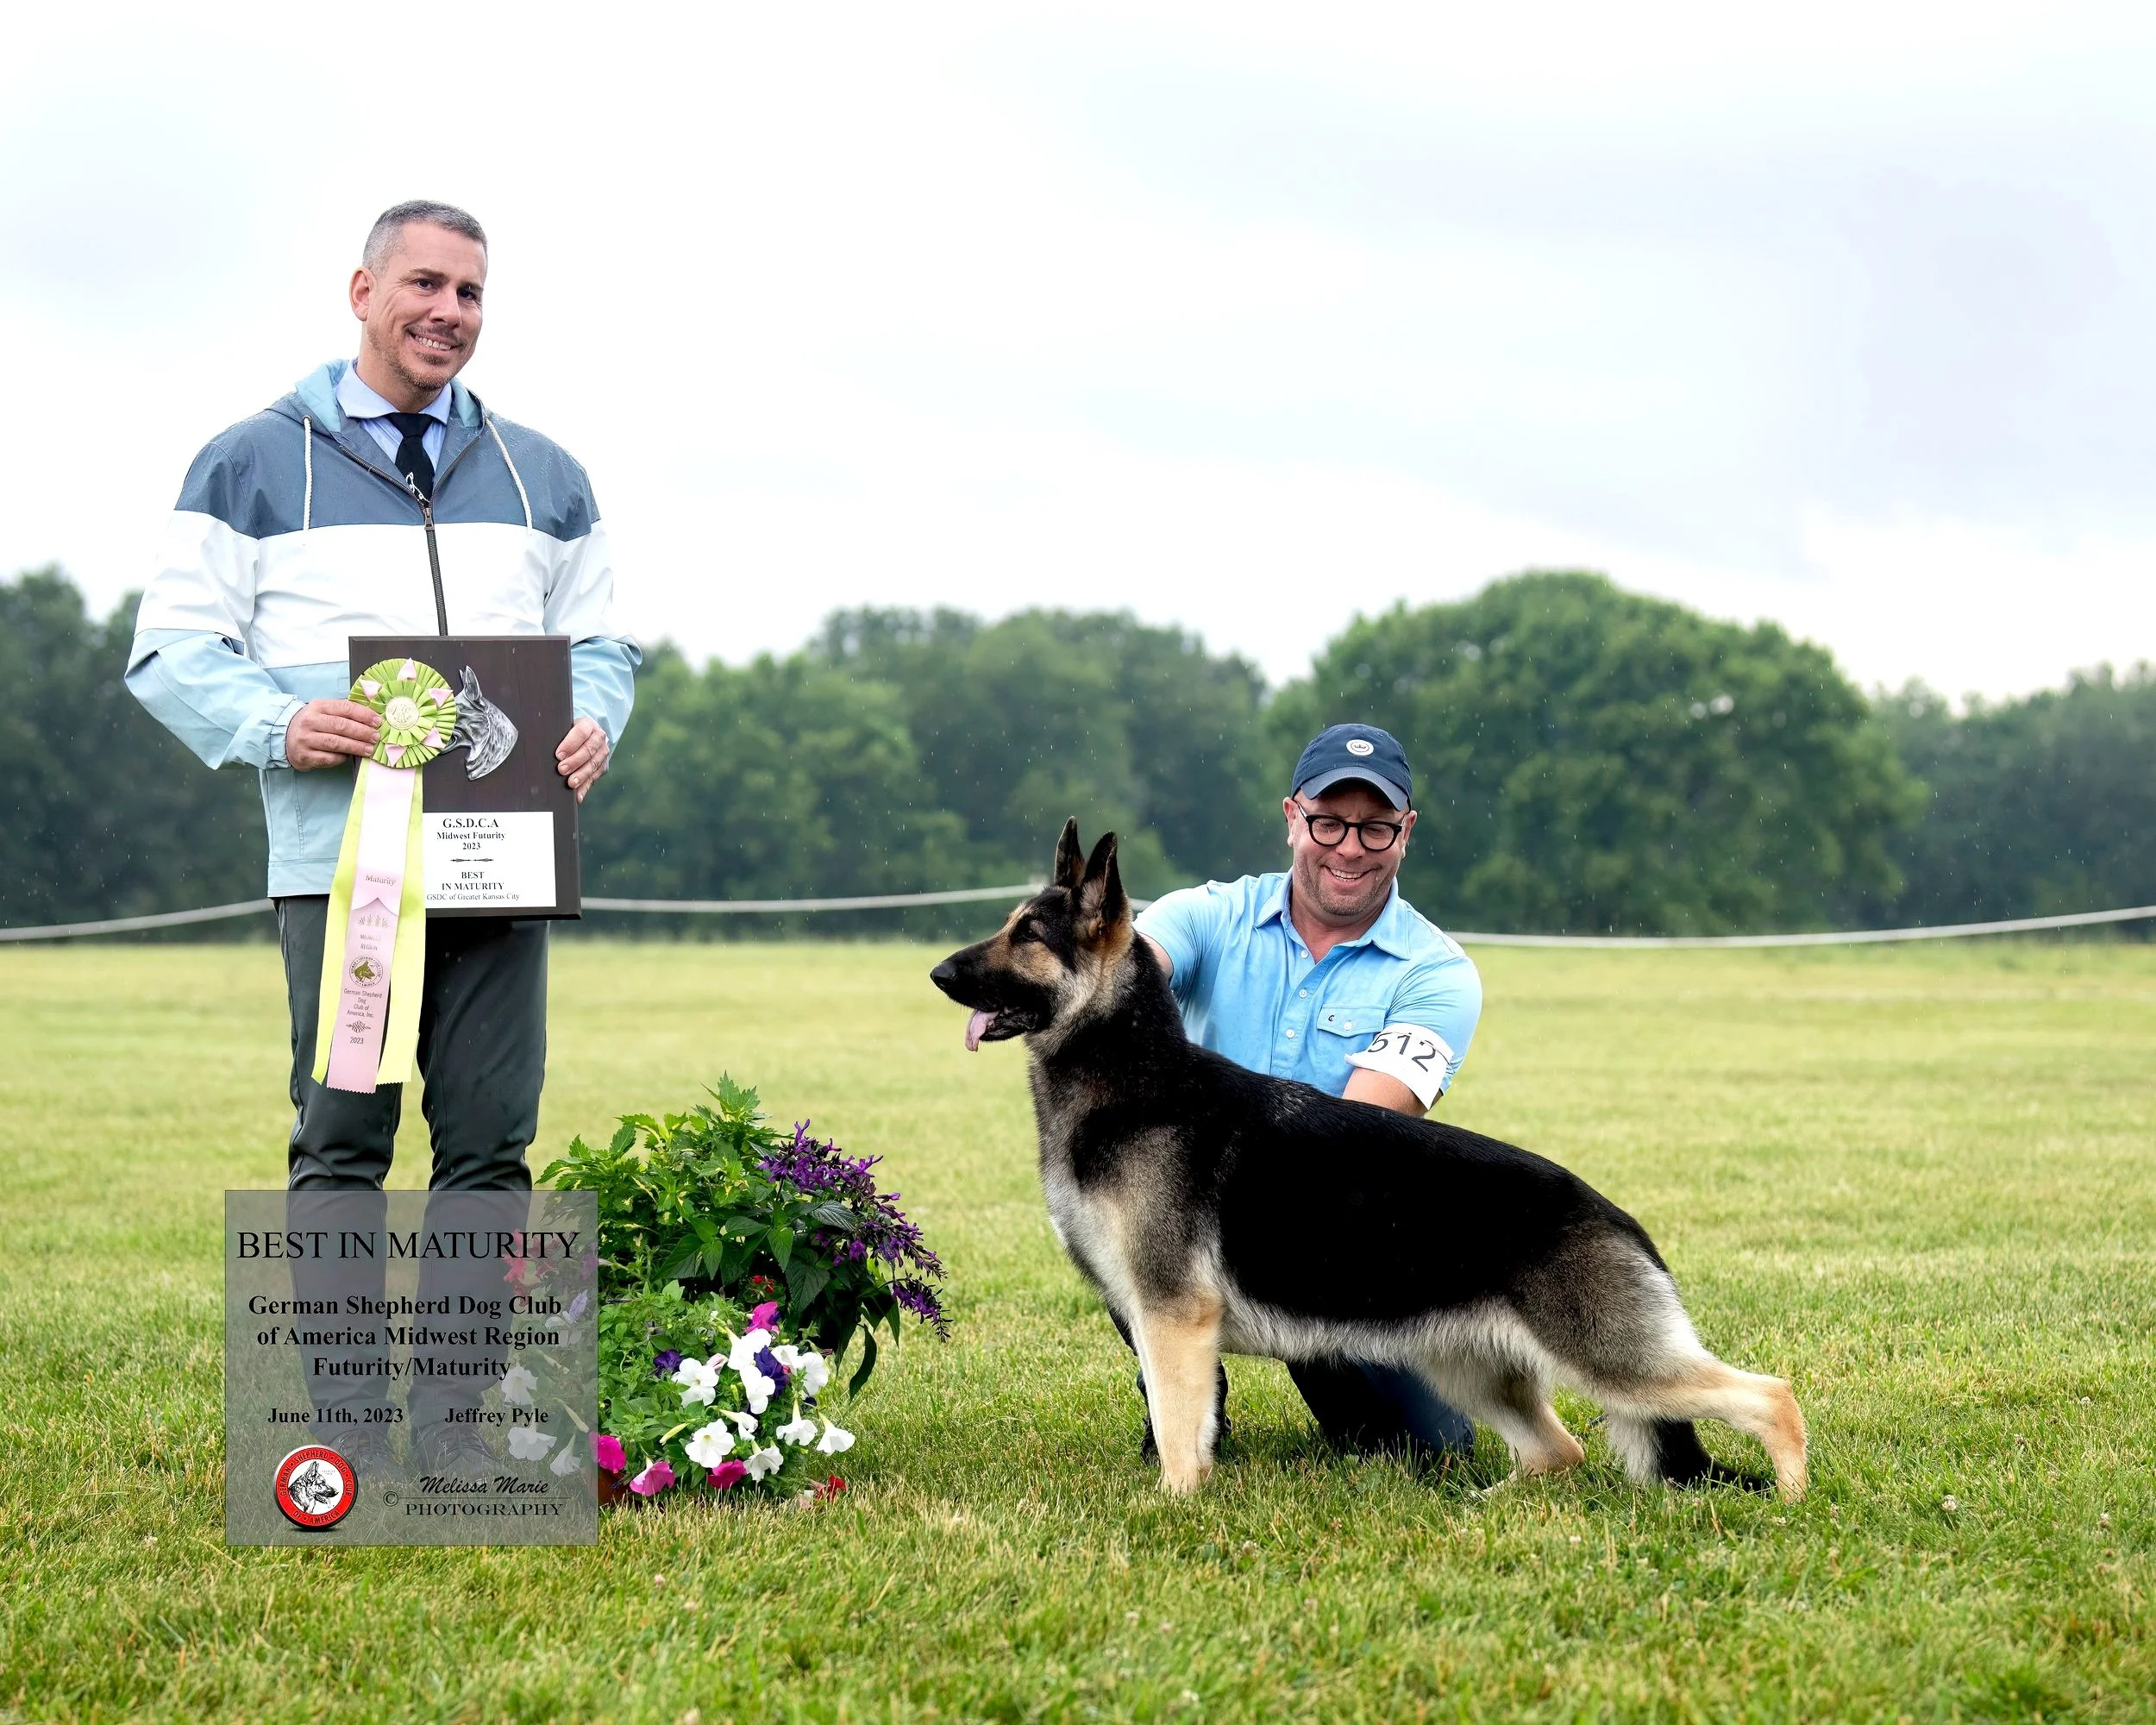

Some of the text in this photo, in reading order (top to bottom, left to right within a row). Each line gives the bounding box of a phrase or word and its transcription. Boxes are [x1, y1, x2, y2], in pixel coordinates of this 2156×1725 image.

[442, 818, 498, 828] G.S.D.C.A
[473, 831, 505, 841] Futurity
[366, 874, 396, 887] Maturity
[1368, 1032, 1436, 1073] 512
